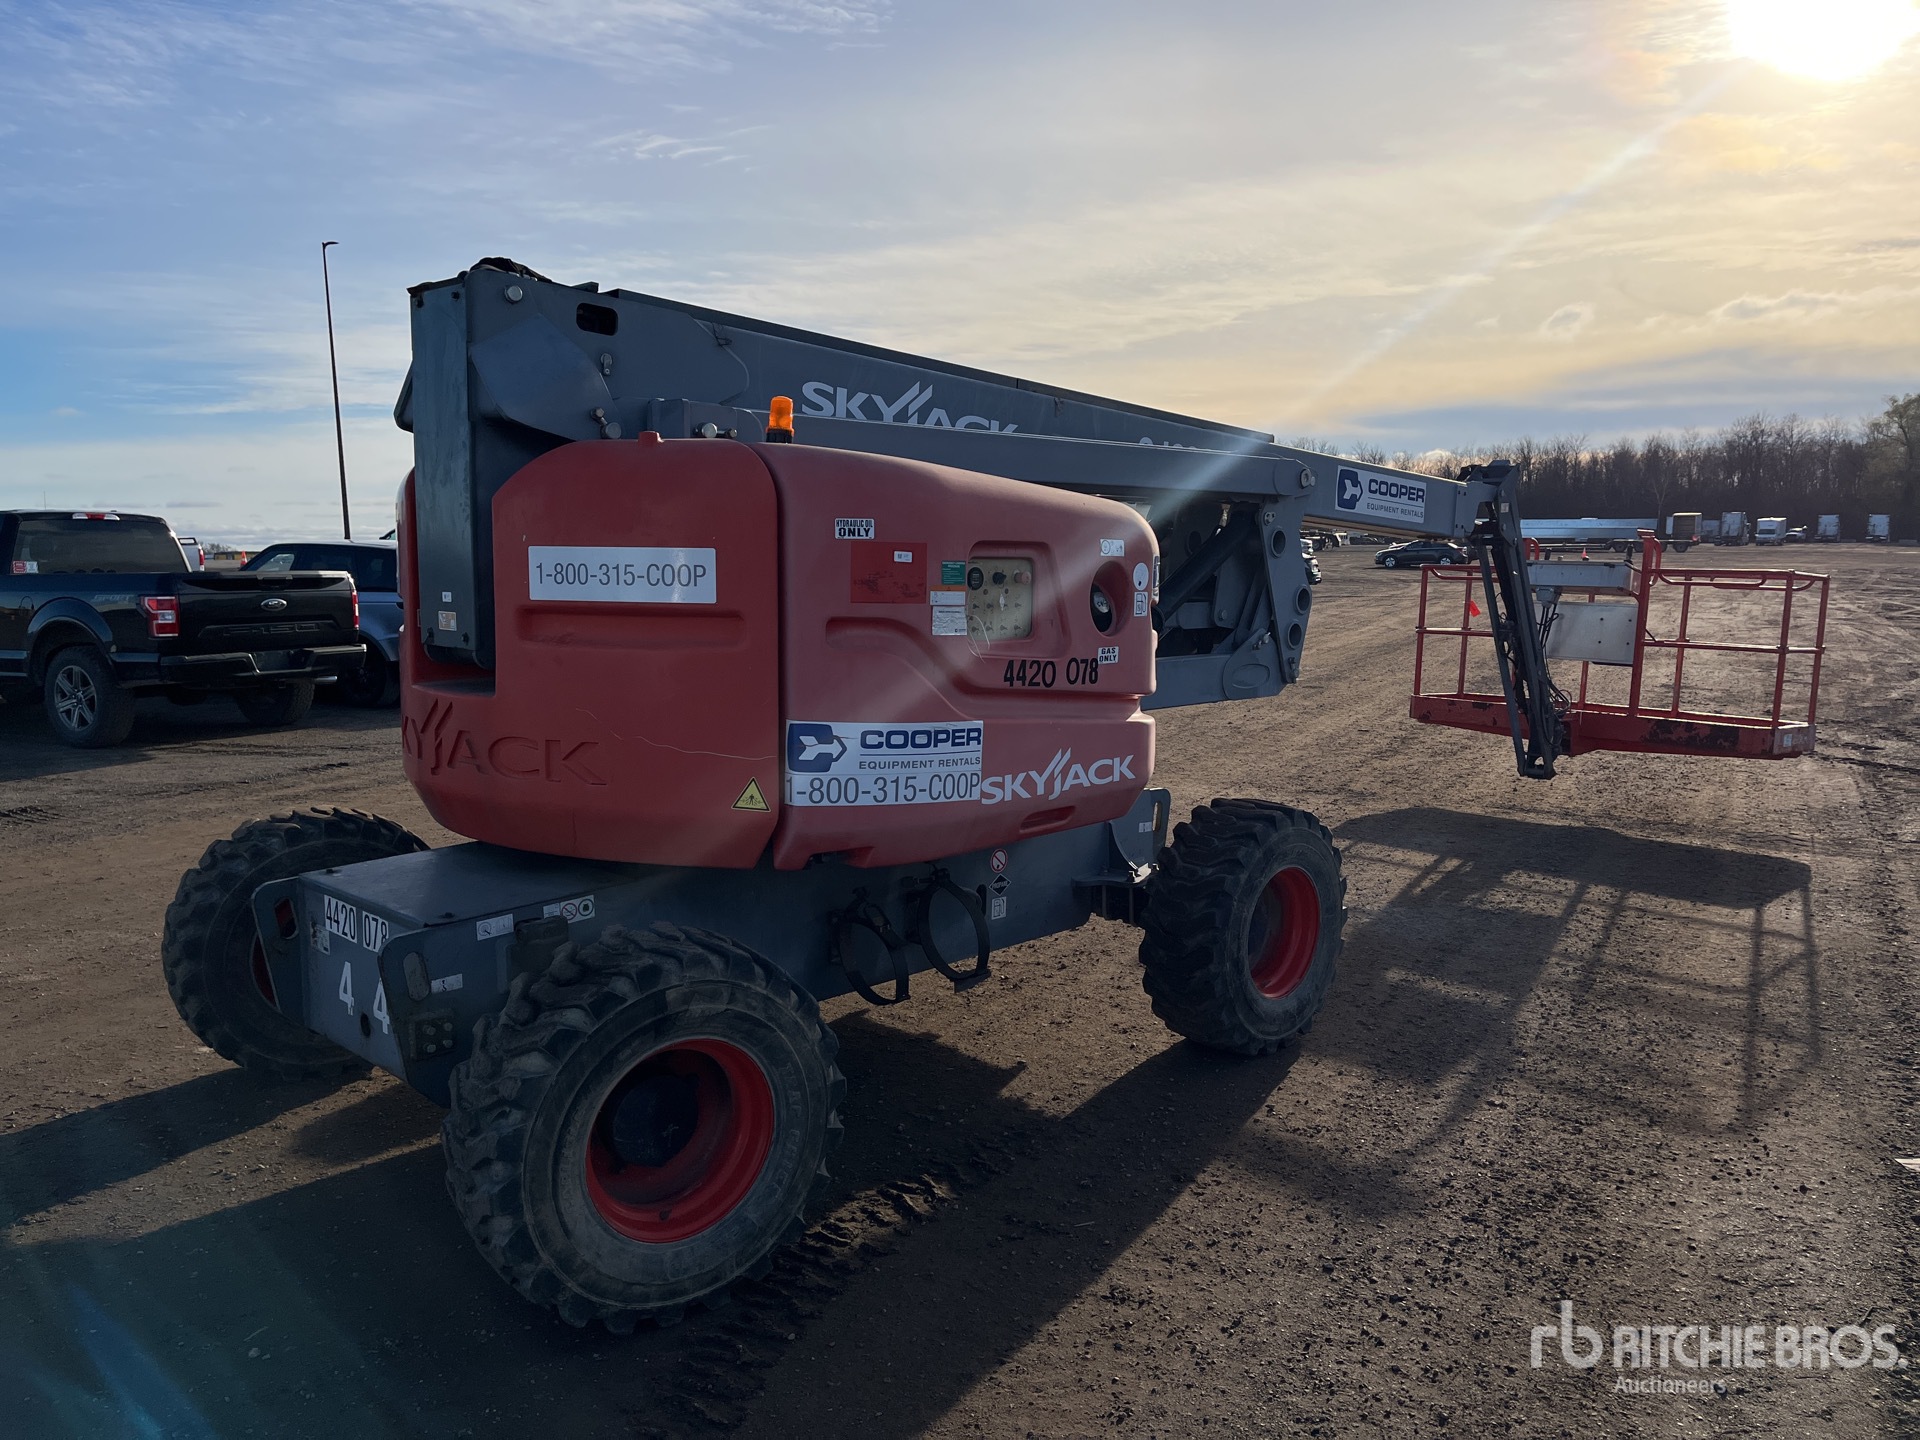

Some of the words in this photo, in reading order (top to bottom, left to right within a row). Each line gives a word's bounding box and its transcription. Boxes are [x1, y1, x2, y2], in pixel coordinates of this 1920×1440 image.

[1369, 478, 1425, 503] COOPER
[1367, 502, 1399, 514] EQUIPMENT
[1401, 508, 1424, 518] RENTALS
[836, 519, 864, 527] HYDRAULIC
[838, 527, 871, 537] ONLY
[536, 562, 707, 587] 1-800-315-COOP
[1099, 654, 1117, 662] ONLY
[1003, 659, 1057, 688] 4420
[1066, 657, 1099, 685] 078
[860, 727, 982, 749] COOPER
[859, 760, 934, 770] EQUIPMENT
[938, 757, 981, 768] RENTALS
[981, 747, 1136, 805] SKYJACK
[786, 773, 980, 804] 1-800-315-COOP
[325, 898, 357, 941] 4420
[338, 961, 355, 1016] 4
